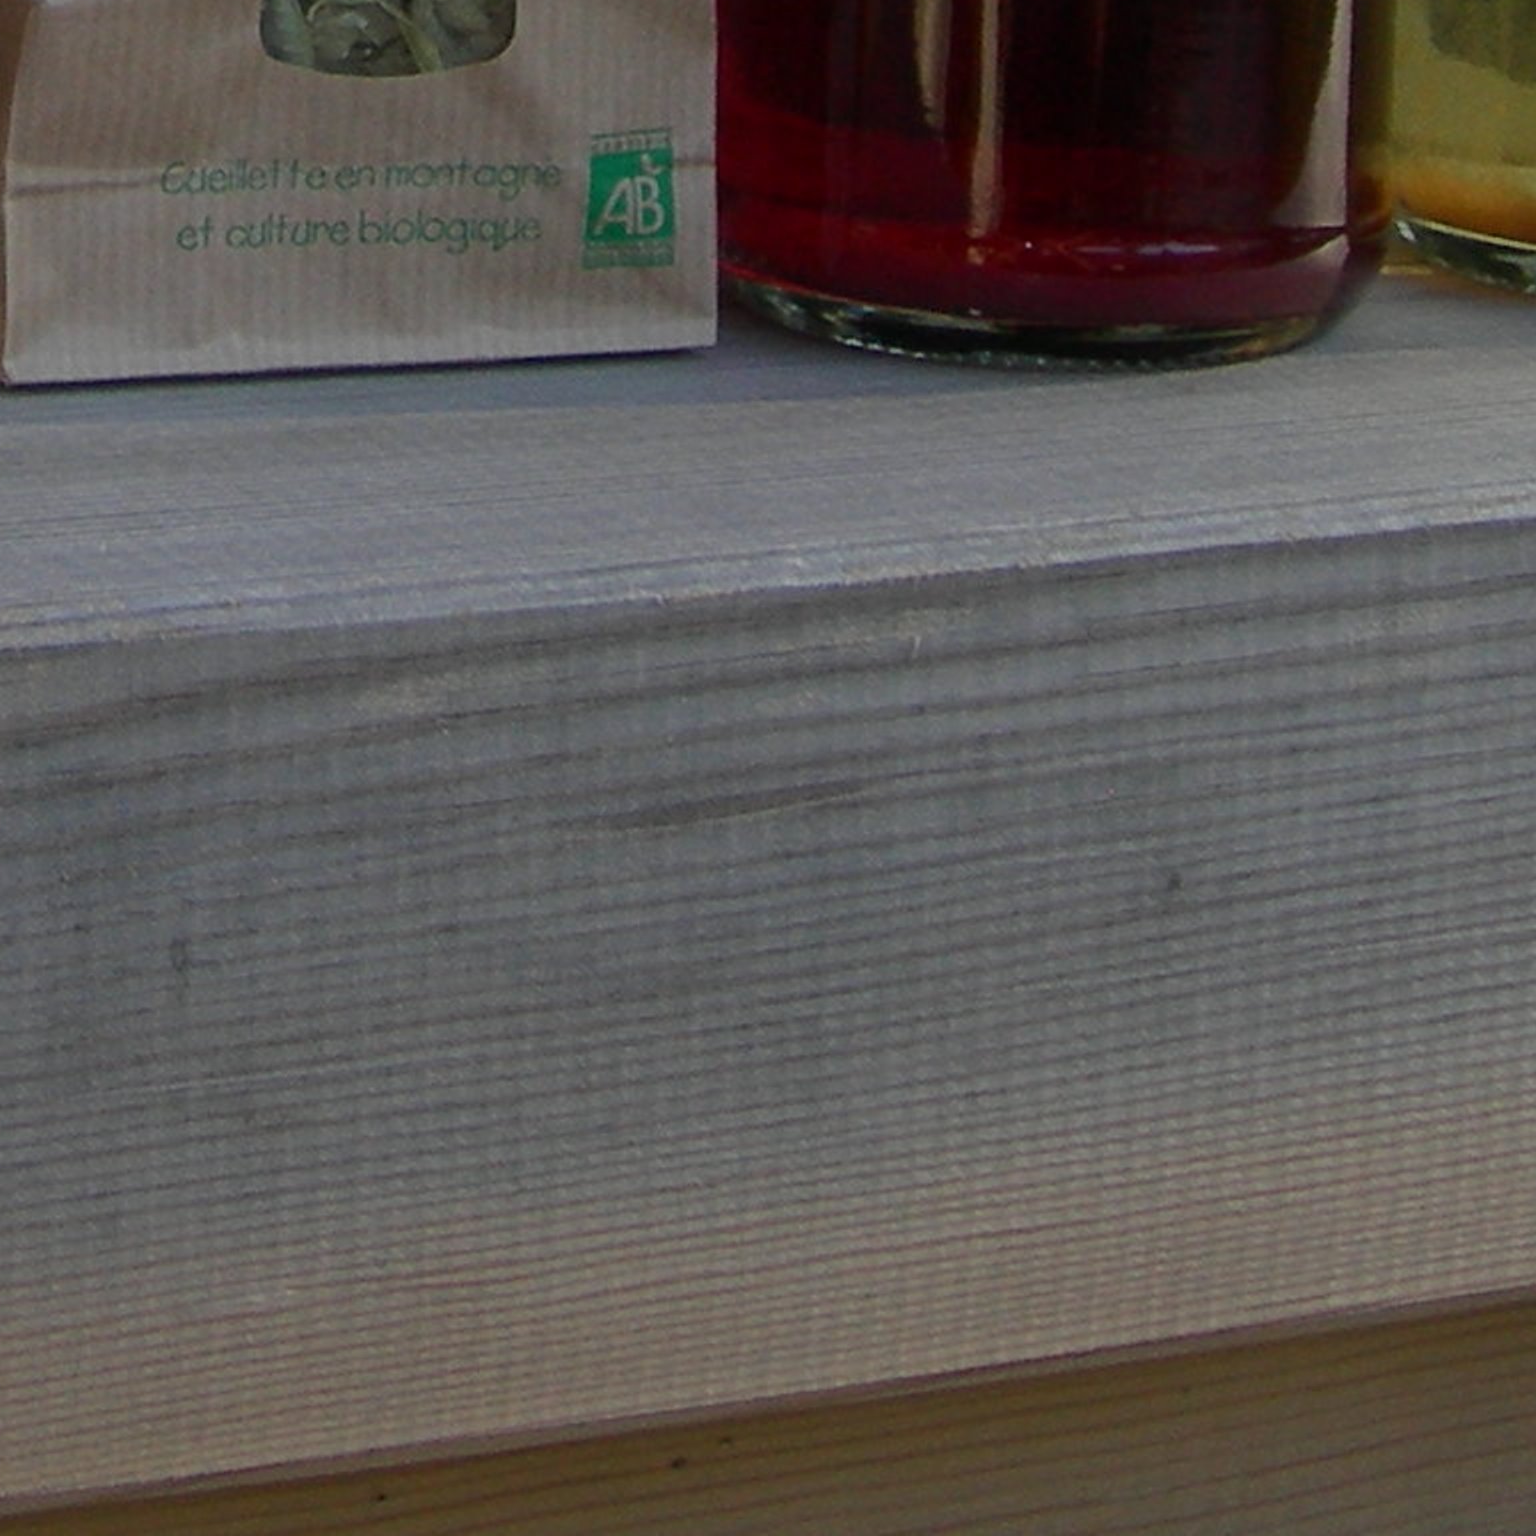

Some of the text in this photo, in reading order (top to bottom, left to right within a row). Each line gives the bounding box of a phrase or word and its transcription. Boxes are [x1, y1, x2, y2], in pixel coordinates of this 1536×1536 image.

[160, 158, 562, 203] Cueillette en montagne
[594, 175, 665, 236] AB
[177, 215, 212, 251] et
[225, 211, 350, 251] culture
[357, 210, 542, 254] biologique
